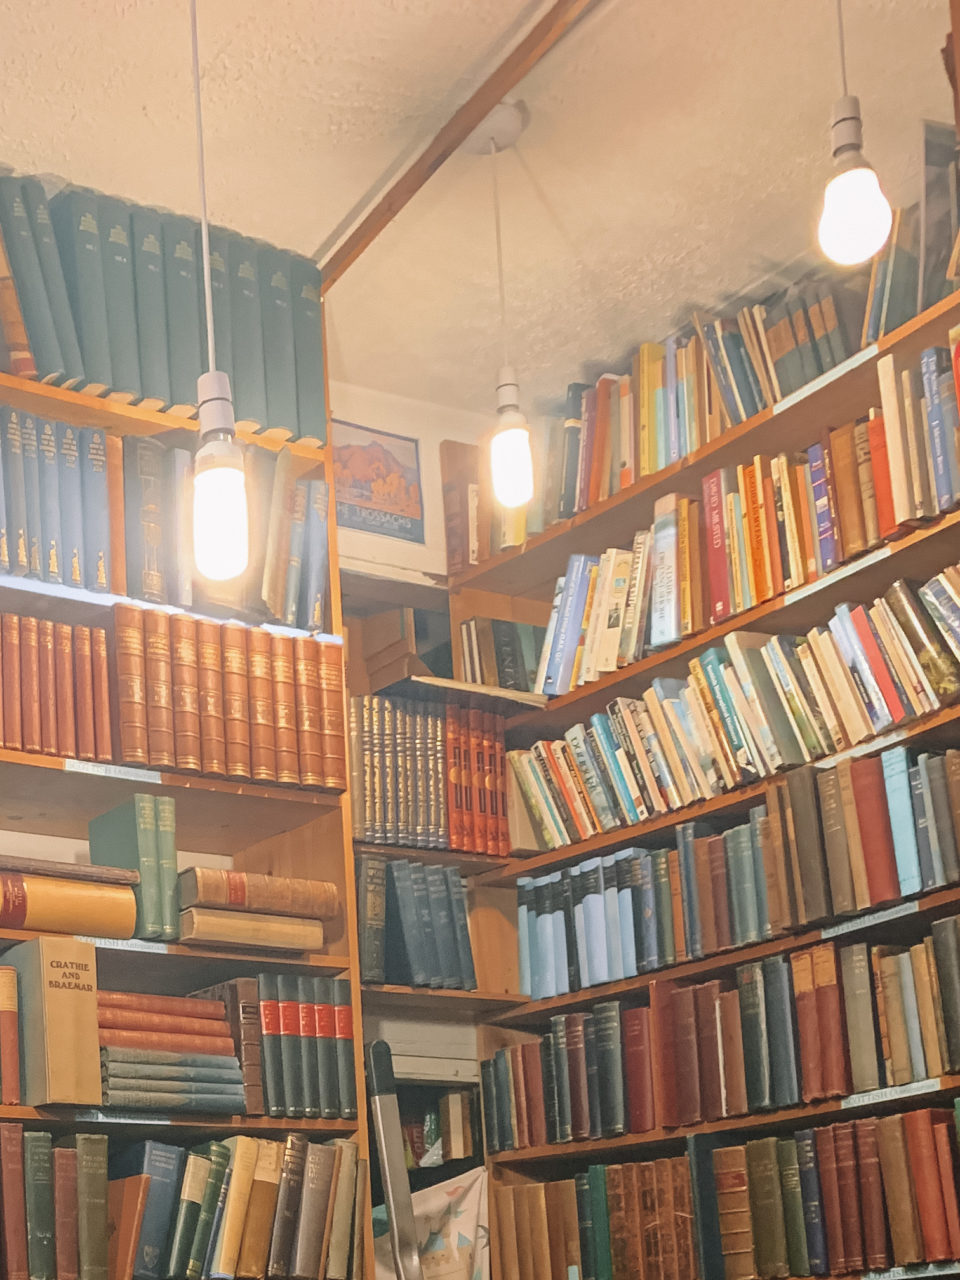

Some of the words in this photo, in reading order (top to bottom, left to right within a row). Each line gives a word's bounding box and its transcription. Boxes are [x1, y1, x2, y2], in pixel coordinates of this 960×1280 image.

[50, 960, 90, 971] CRATHIE
[62, 971, 81, 981] AND
[48, 980, 93, 992] BRAEMAR
